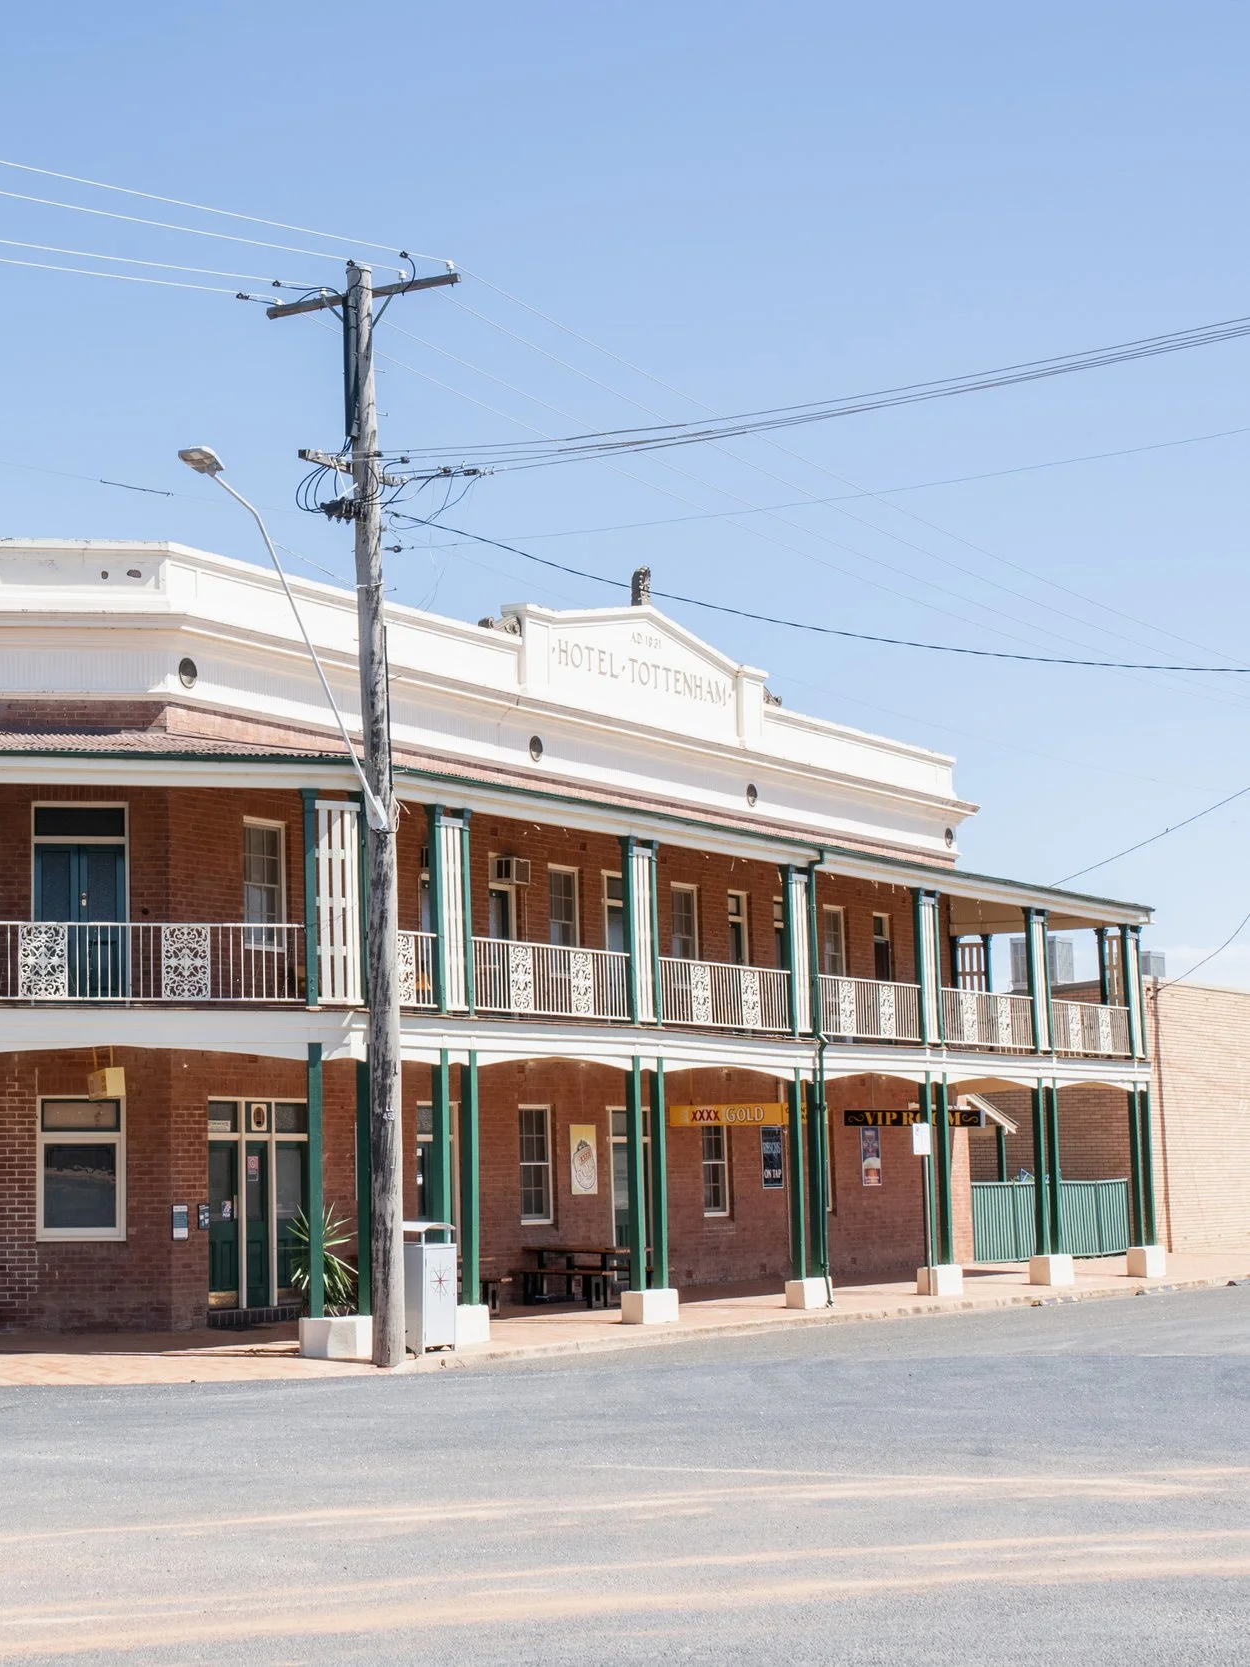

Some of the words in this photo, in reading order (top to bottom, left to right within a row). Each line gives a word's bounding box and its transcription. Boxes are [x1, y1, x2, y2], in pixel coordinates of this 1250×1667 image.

[558, 639, 619, 679] HOTEL
[628, 657, 727, 706] TOTTENHAM
[691, 1109, 721, 1122] XXXX
[725, 1106, 765, 1123] GOLD
[863, 1111, 898, 1126] VIP
[764, 1168, 772, 1179] ON
